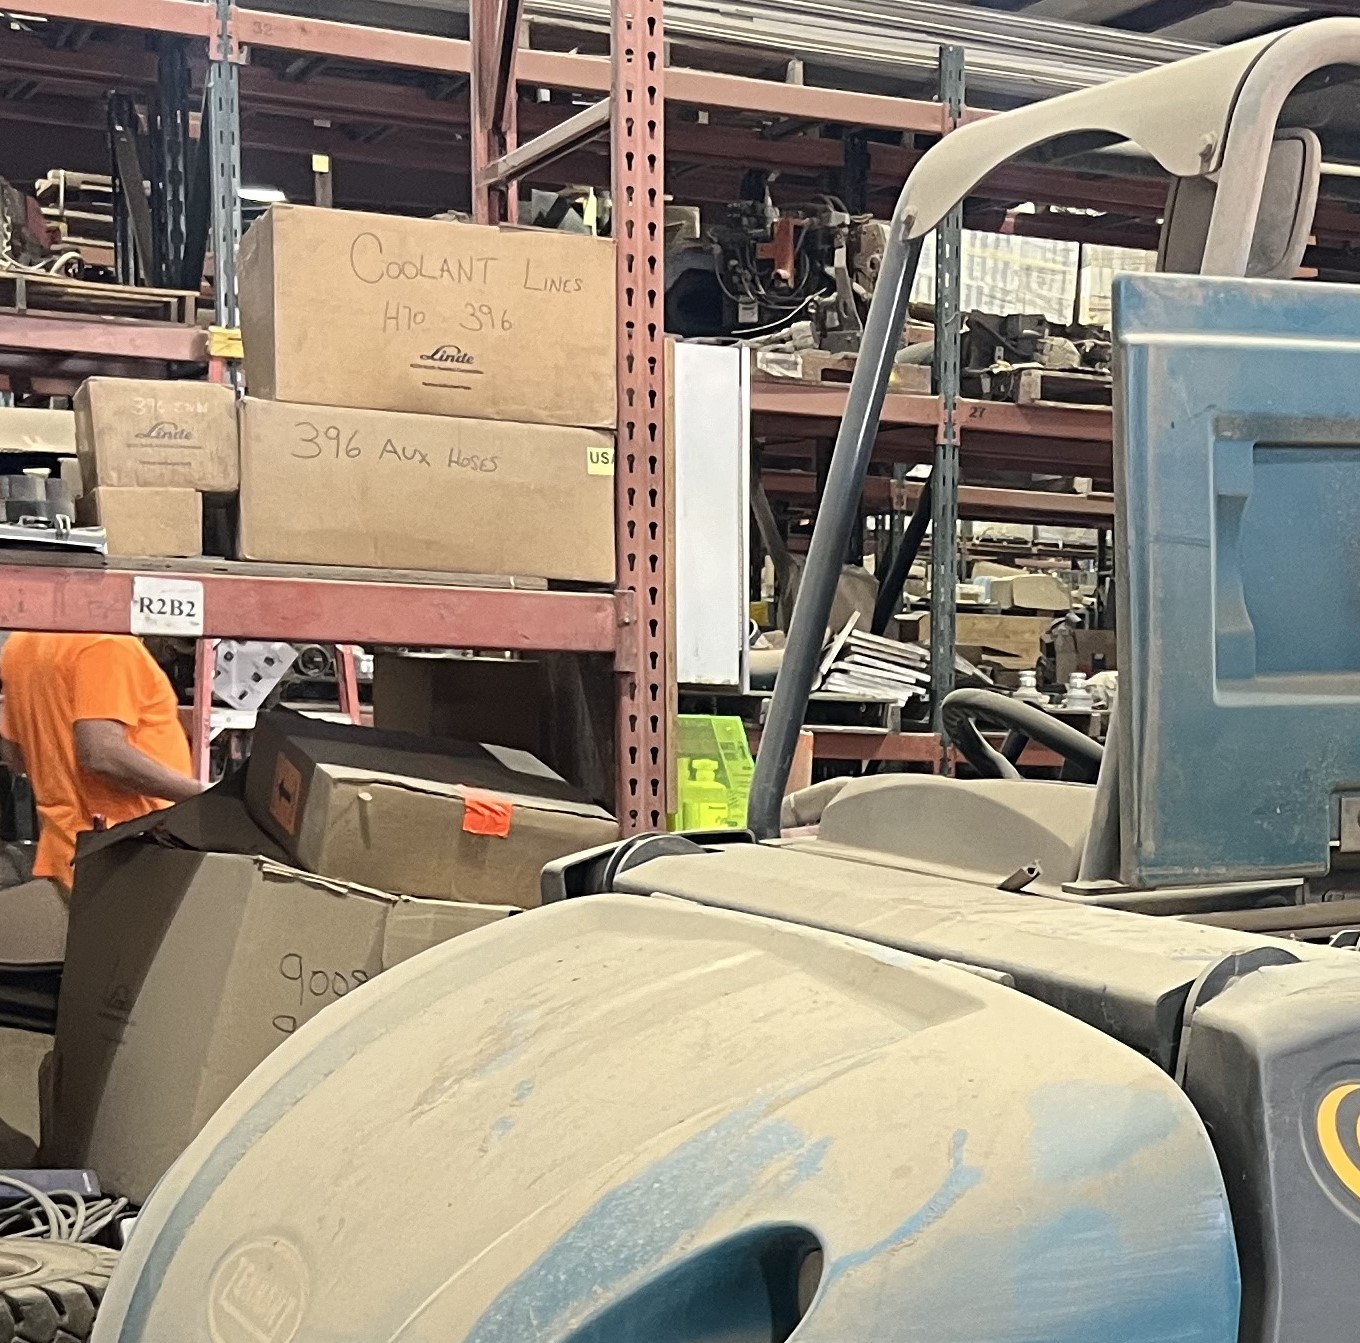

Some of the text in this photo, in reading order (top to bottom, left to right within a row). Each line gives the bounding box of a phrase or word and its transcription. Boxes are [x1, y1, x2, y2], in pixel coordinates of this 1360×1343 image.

[459, 302, 513, 331] 396
[419, 344, 474, 365] Linde
[968, 406, 986, 419] 27
[134, 420, 193, 440] Linde
[291, 421, 362, 459] 396
[138, 595, 197, 617] R2B2
